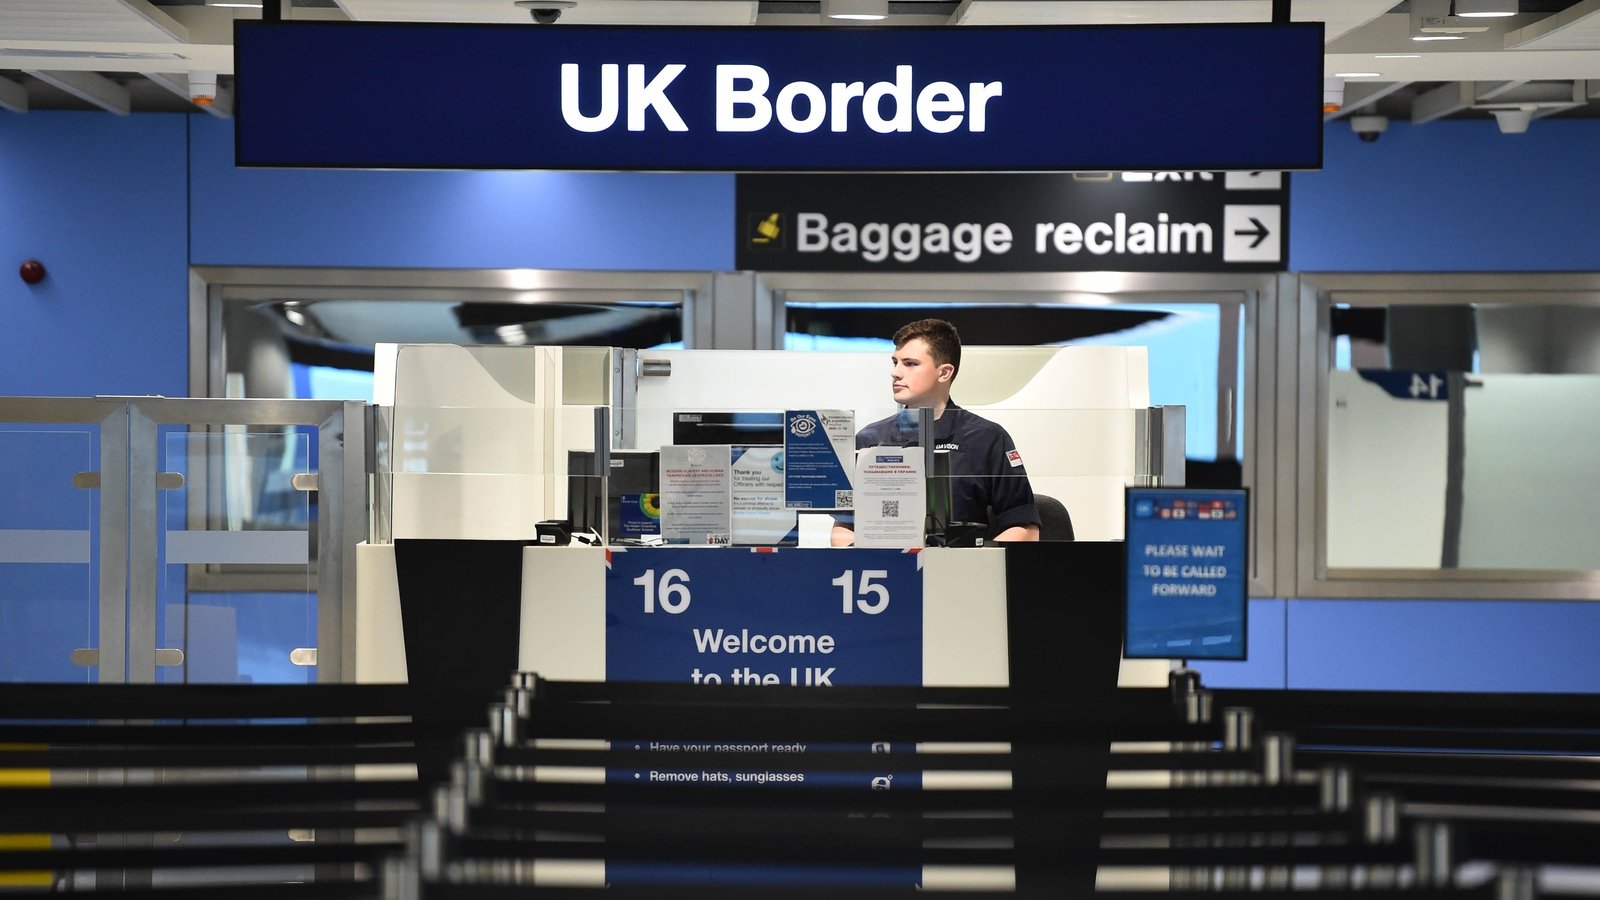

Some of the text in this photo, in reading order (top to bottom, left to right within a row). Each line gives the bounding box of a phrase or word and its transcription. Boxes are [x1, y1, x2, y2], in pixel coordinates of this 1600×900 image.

[560, 63, 1003, 134] UK Border
[796, 212, 1213, 263] Baggage reclaim
[1145, 544, 1226, 558] PLEASE WAIT
[1143, 564, 1227, 579] TO BE CALLED
[633, 568, 691, 614] 16
[832, 569, 890, 615] 15
[1152, 583, 1217, 597] FORWARD
[692, 628, 835, 654] Welcome
[690, 667, 723, 685] to
[730, 667, 781, 686] the
[650, 741, 680, 752] Have
[649, 770, 805, 784] Remove hats, sunglasses
